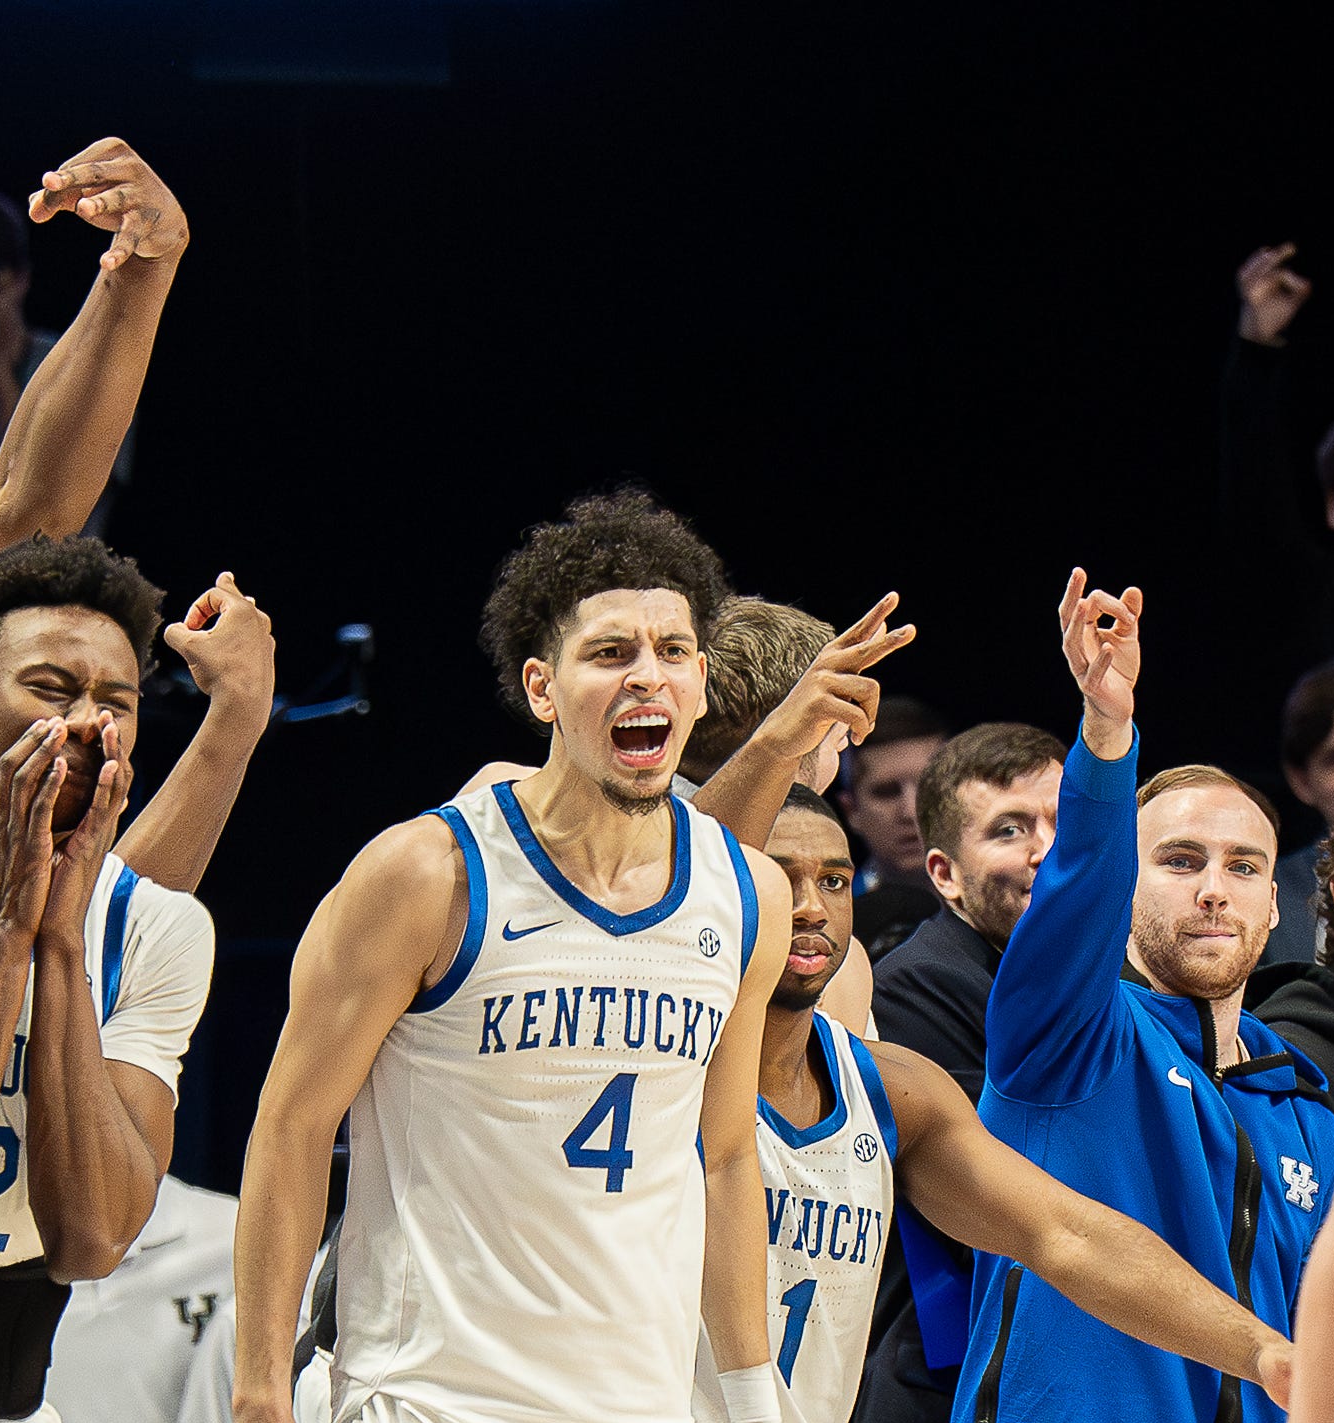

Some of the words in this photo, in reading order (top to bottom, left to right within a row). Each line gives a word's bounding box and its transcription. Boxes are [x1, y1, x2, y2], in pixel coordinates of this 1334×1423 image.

[698, 927, 720, 958] SEC
[478, 986, 723, 1067] KENTUCKY
[562, 1073, 638, 1193] 4
[854, 1133, 878, 1163] SEC
[1278, 1154, 1320, 1213] UK
[777, 1278, 817, 1390] 1
